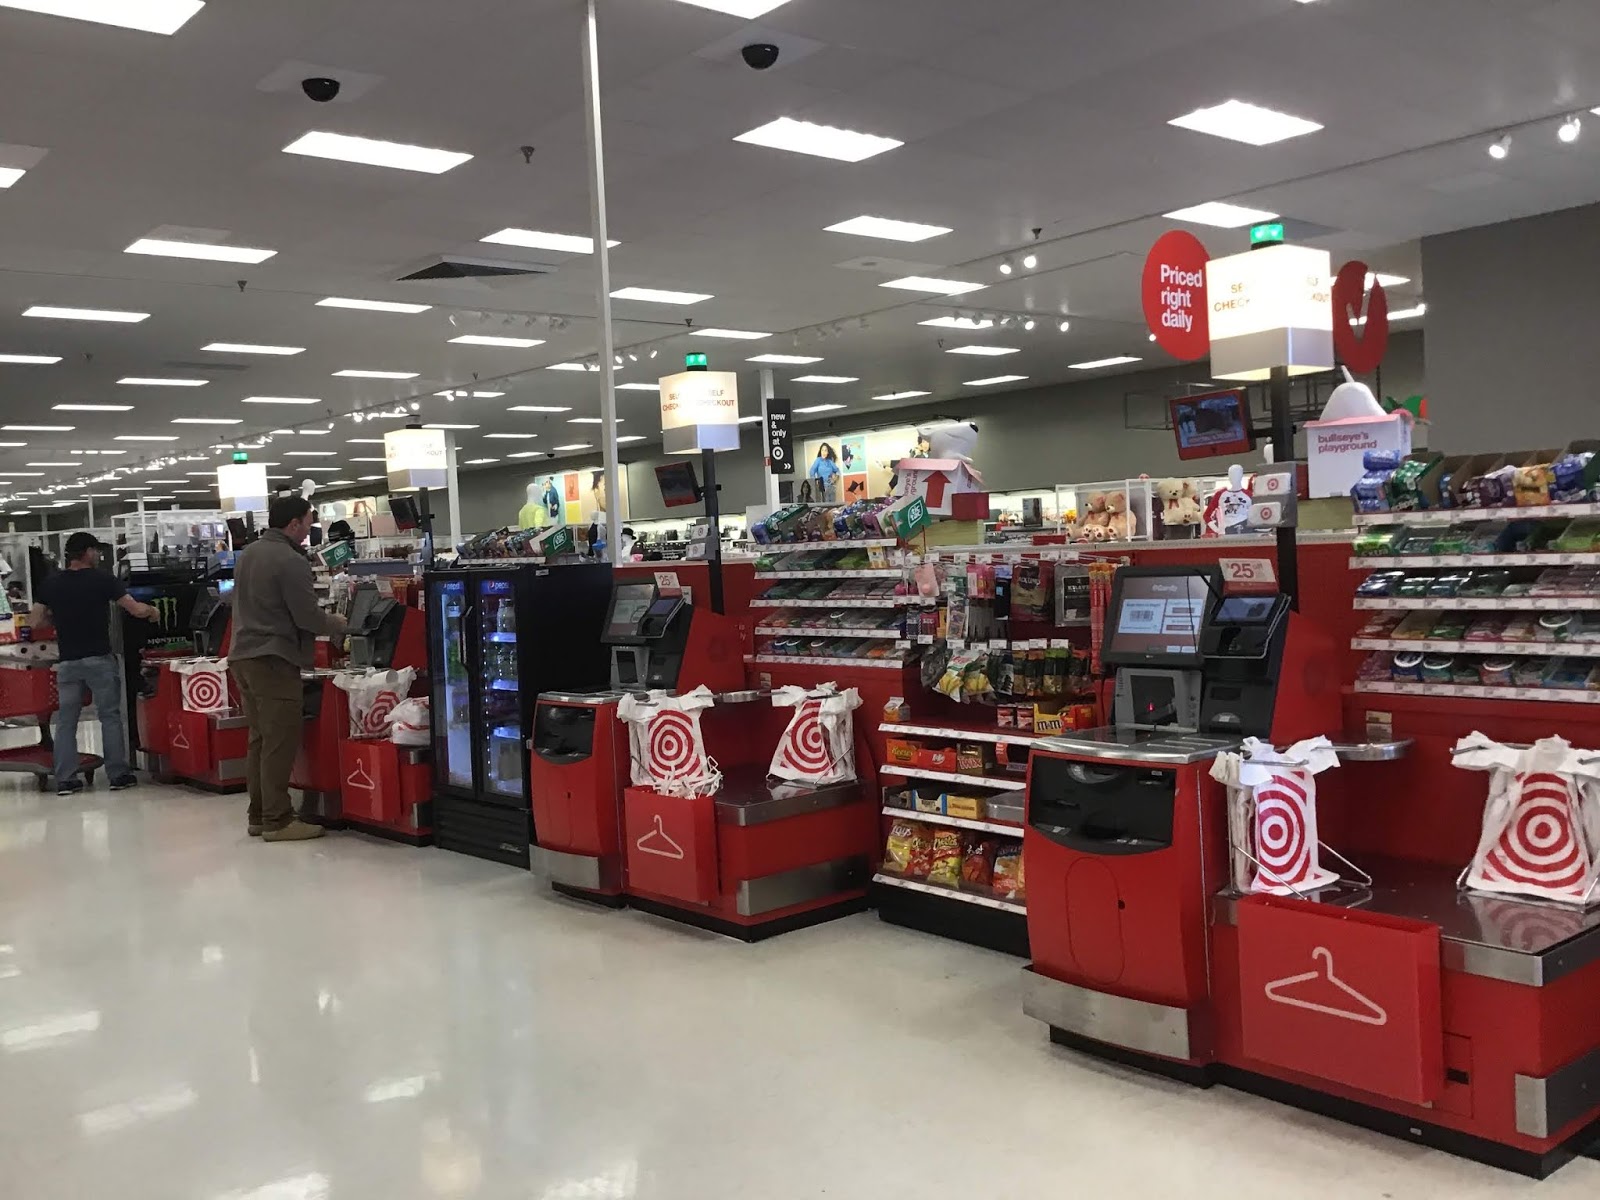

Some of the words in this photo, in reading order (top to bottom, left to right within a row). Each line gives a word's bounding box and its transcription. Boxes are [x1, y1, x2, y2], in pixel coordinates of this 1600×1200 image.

[1160, 263, 1203, 288] Priced
[1161, 289, 1192, 308] right
[1161, 308, 1193, 332] daily
[771, 413, 786, 421] new
[771, 421, 777, 429] &
[772, 430, 787, 438] only
[1318, 431, 1369, 443] bullseye's
[772, 438, 780, 446] at
[1318, 440, 1377, 454] playground
